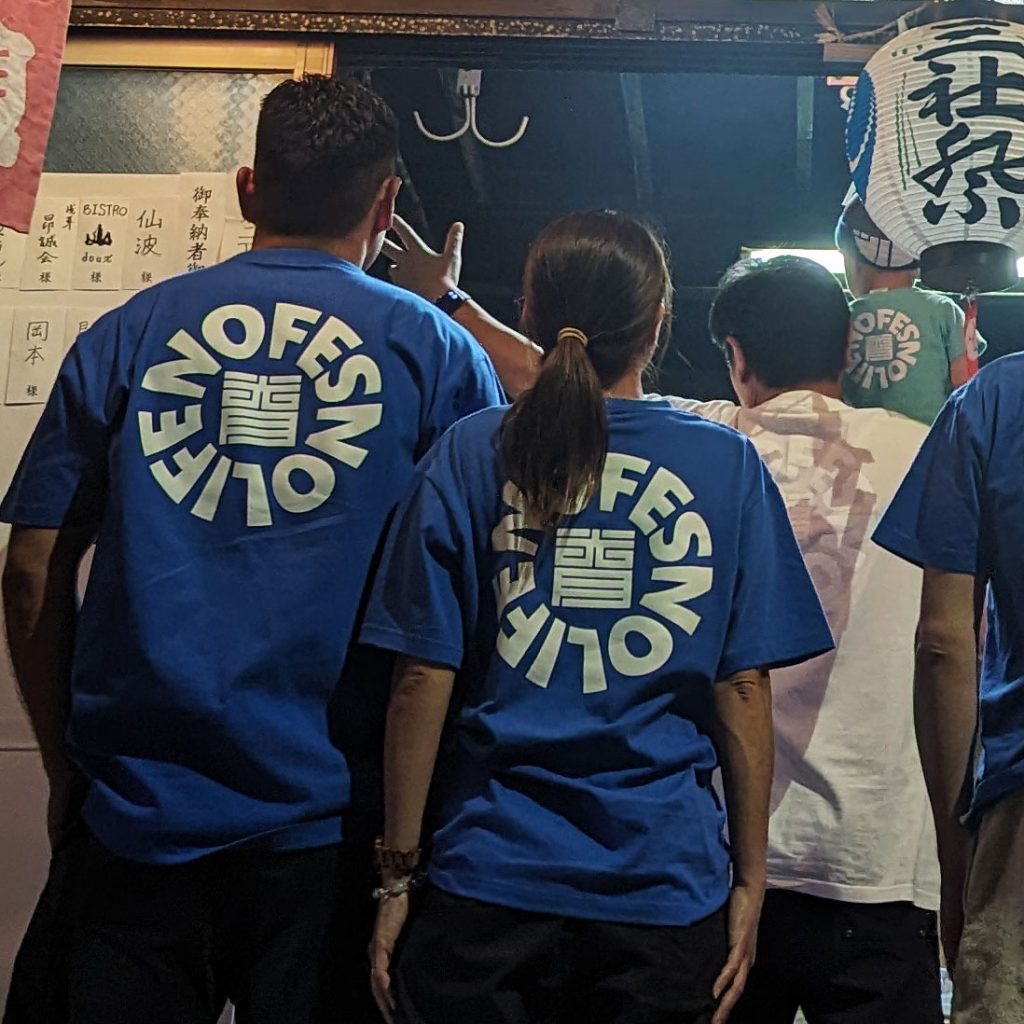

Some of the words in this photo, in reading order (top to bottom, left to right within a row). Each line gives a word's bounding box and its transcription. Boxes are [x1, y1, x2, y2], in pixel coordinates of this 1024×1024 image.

[83, 203, 128, 217] BISTRO
[133, 208, 163, 257] 仙波
[81, 252, 113, 264] doux
[24, 320, 49, 366] 岡本
